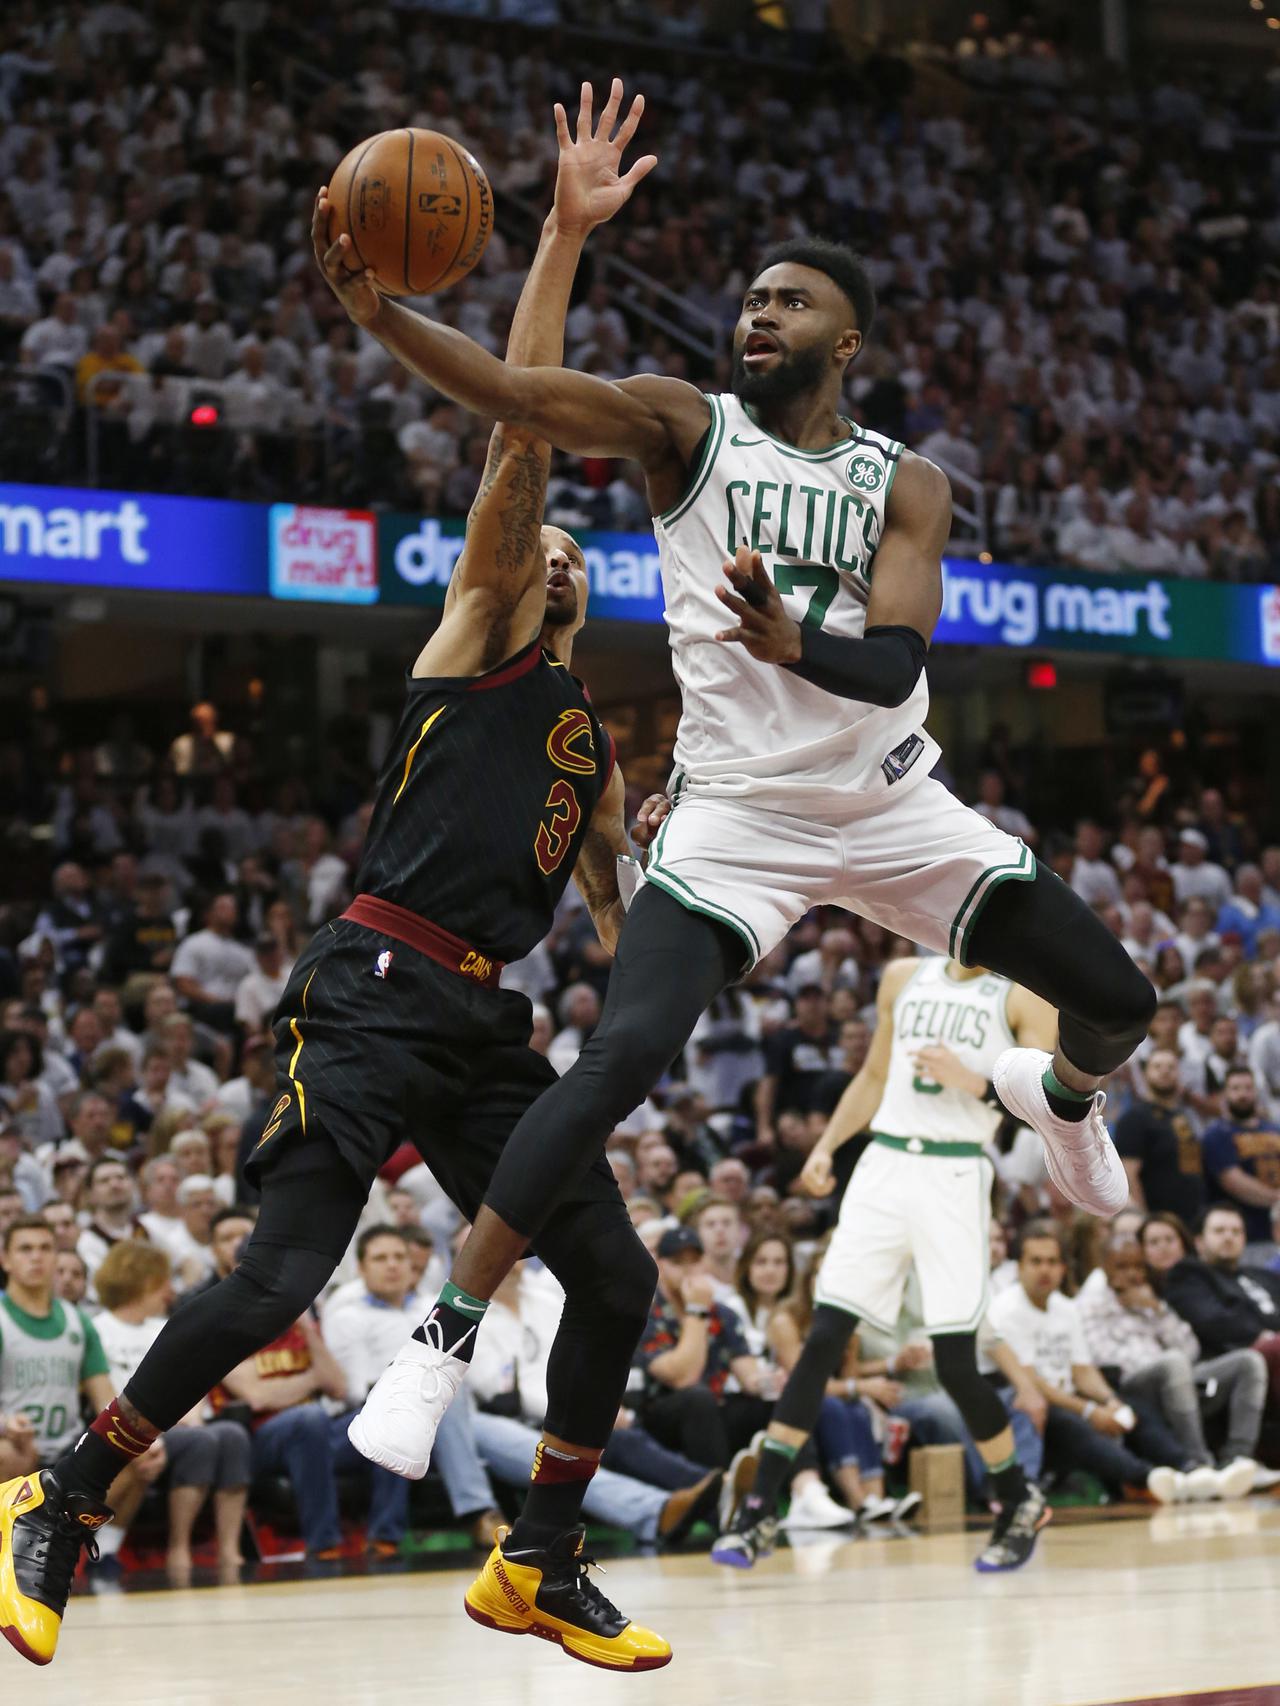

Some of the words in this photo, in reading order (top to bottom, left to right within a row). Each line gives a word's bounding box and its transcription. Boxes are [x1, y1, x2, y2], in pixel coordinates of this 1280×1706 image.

[280, 515, 358, 563] drug
[773, 564, 840, 632] 7
[1045, 581, 1171, 640] mart
[534, 779, 581, 875] 3
[460, 951, 492, 980] CAVS
[898, 1000, 990, 1049] CELTICS
[15, 1355, 76, 1392] BOSTON
[21, 1403, 67, 1439] 20
